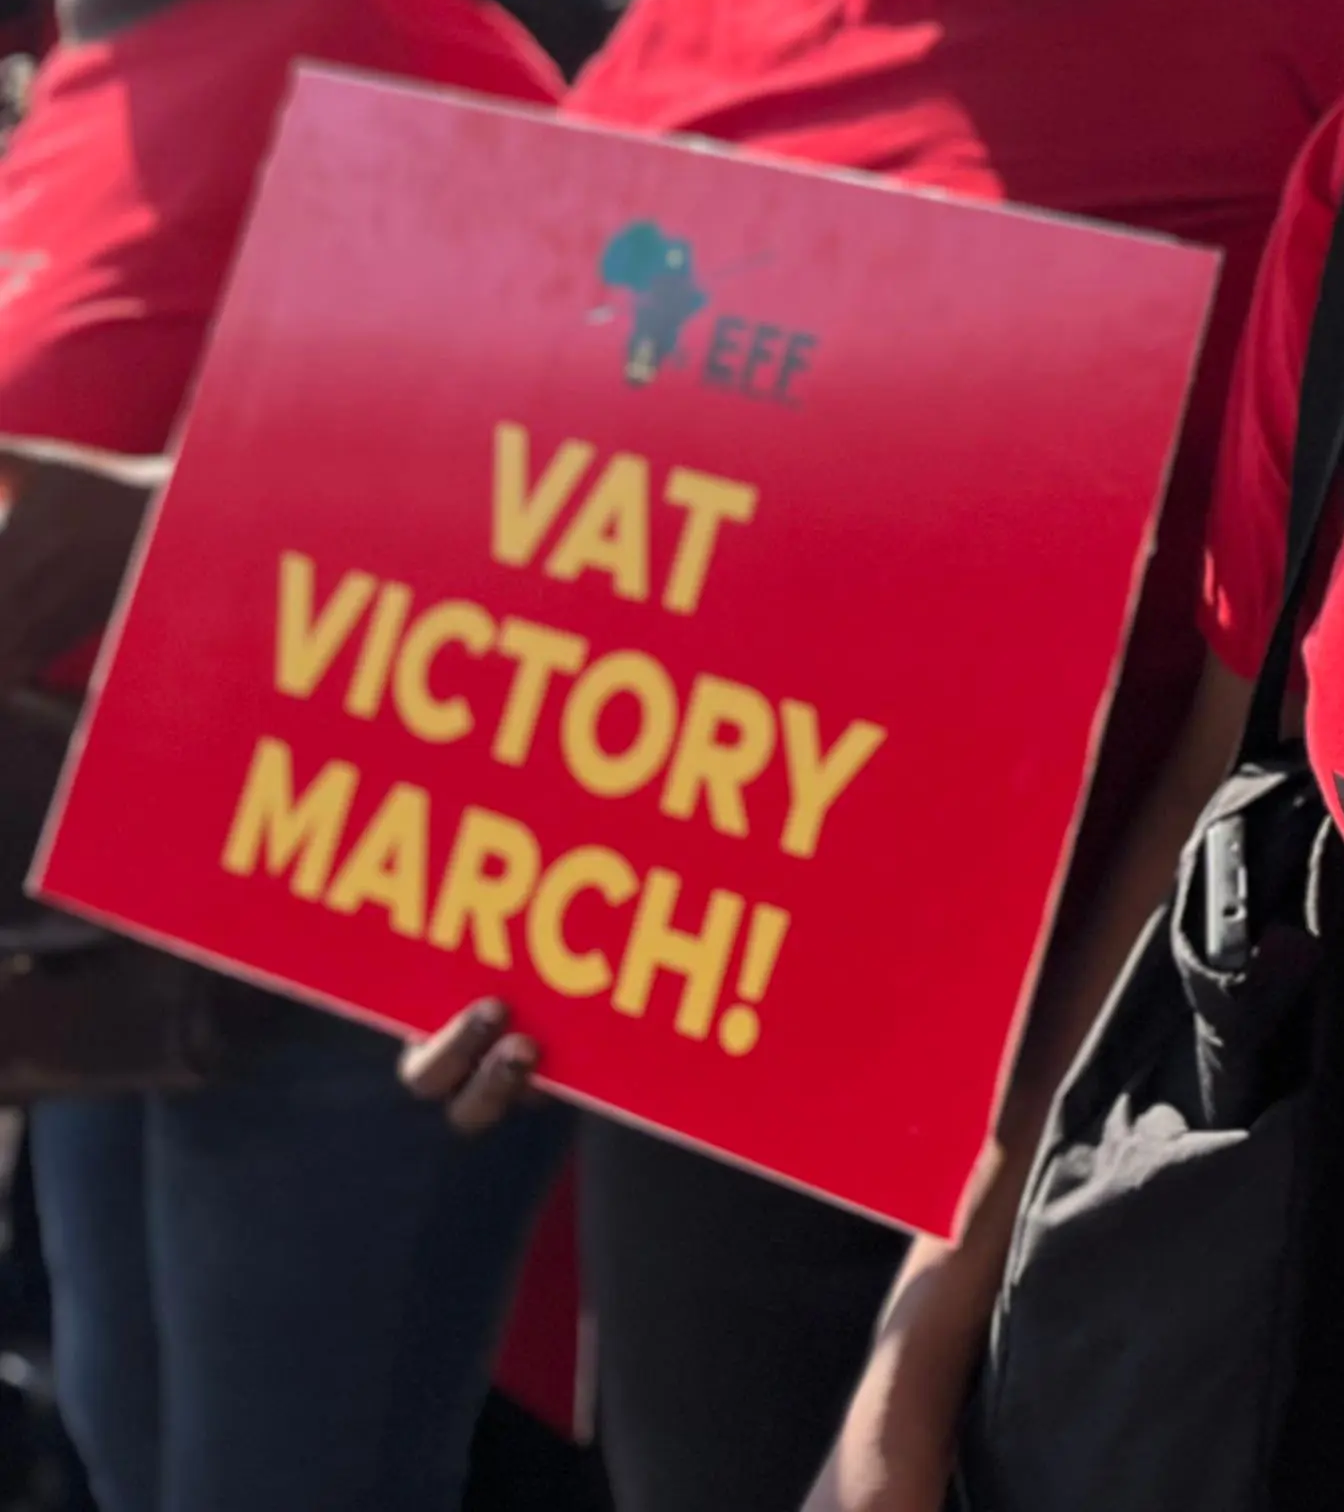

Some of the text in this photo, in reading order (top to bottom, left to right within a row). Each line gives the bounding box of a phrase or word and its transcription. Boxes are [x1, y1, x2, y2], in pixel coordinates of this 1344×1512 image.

[702, 316, 818, 398] EFF
[491, 422, 758, 615] VAT
[273, 551, 887, 859] VICTORY
[221, 737, 792, 1056] MARCH!
